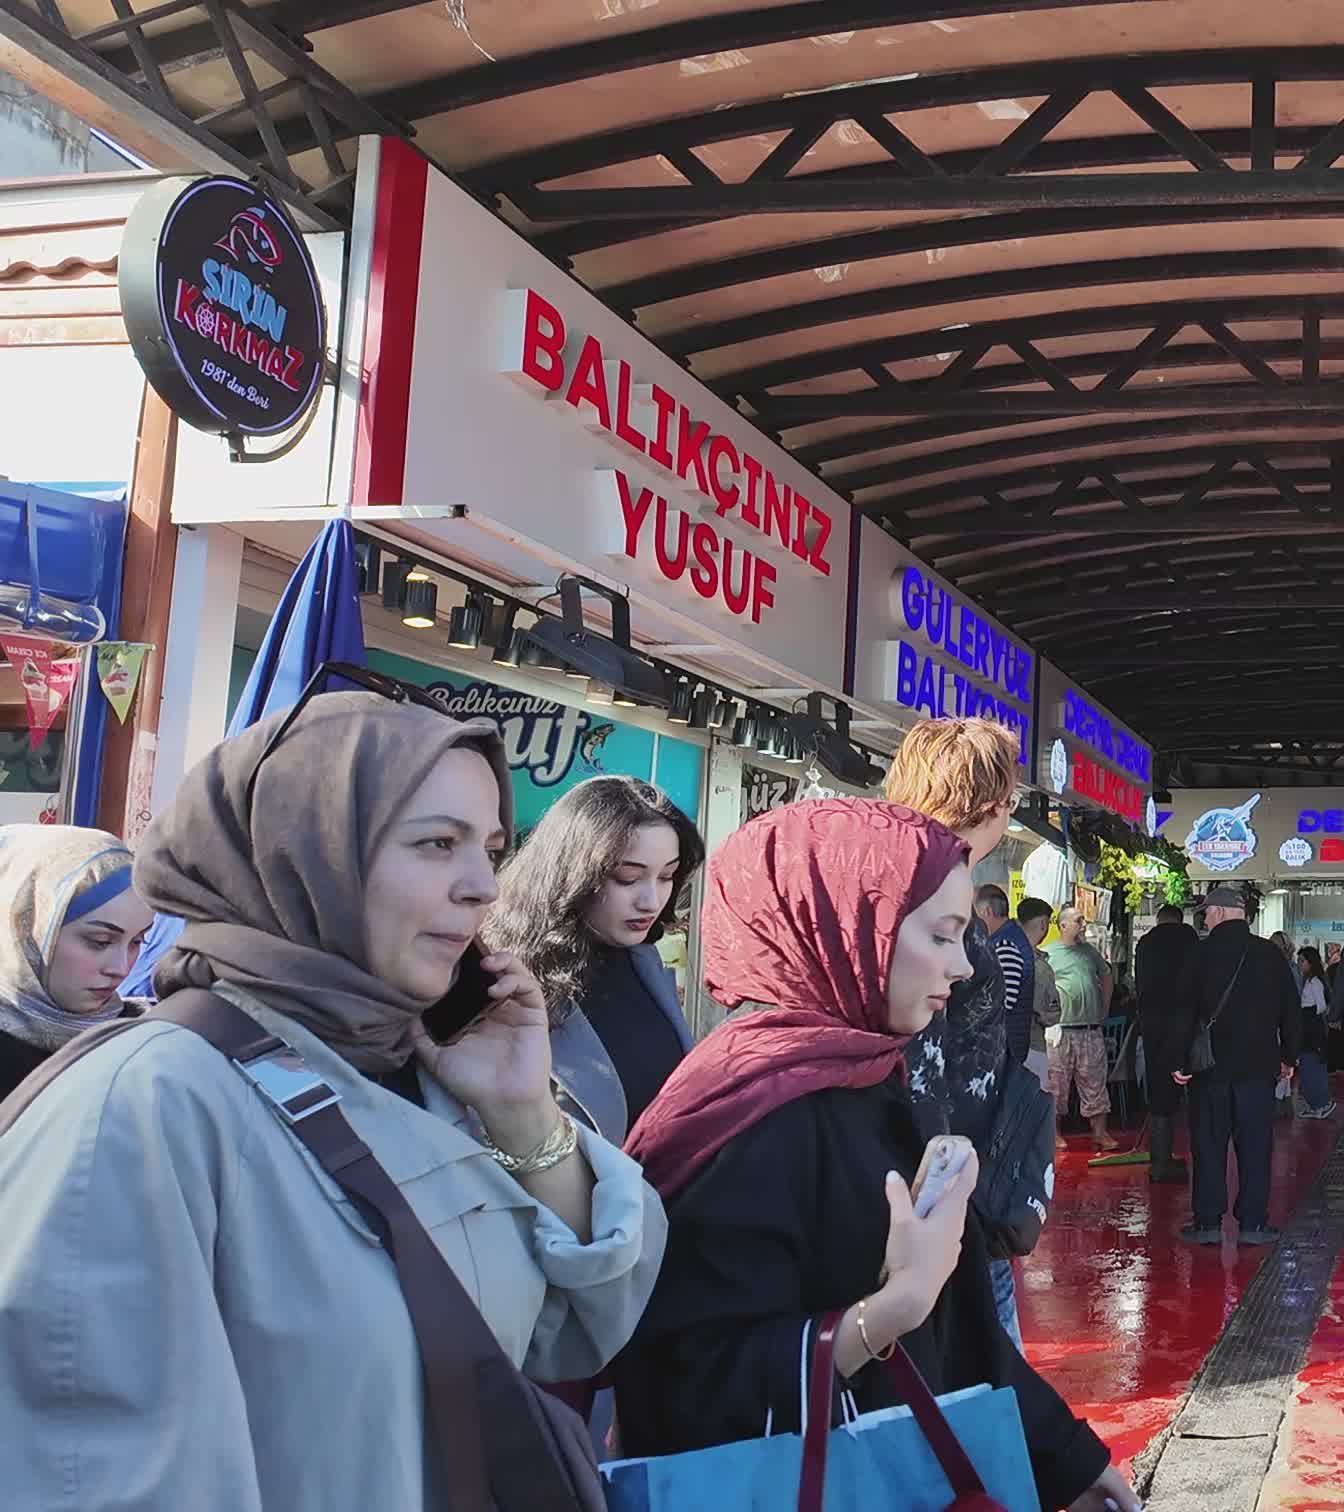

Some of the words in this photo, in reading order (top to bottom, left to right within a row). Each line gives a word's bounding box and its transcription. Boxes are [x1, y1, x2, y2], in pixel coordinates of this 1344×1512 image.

[174, 278, 304, 392] KORKMAZ
[521, 287, 833, 577] BALIKÇINIZ
[613, 468, 778, 625] YUSUF
